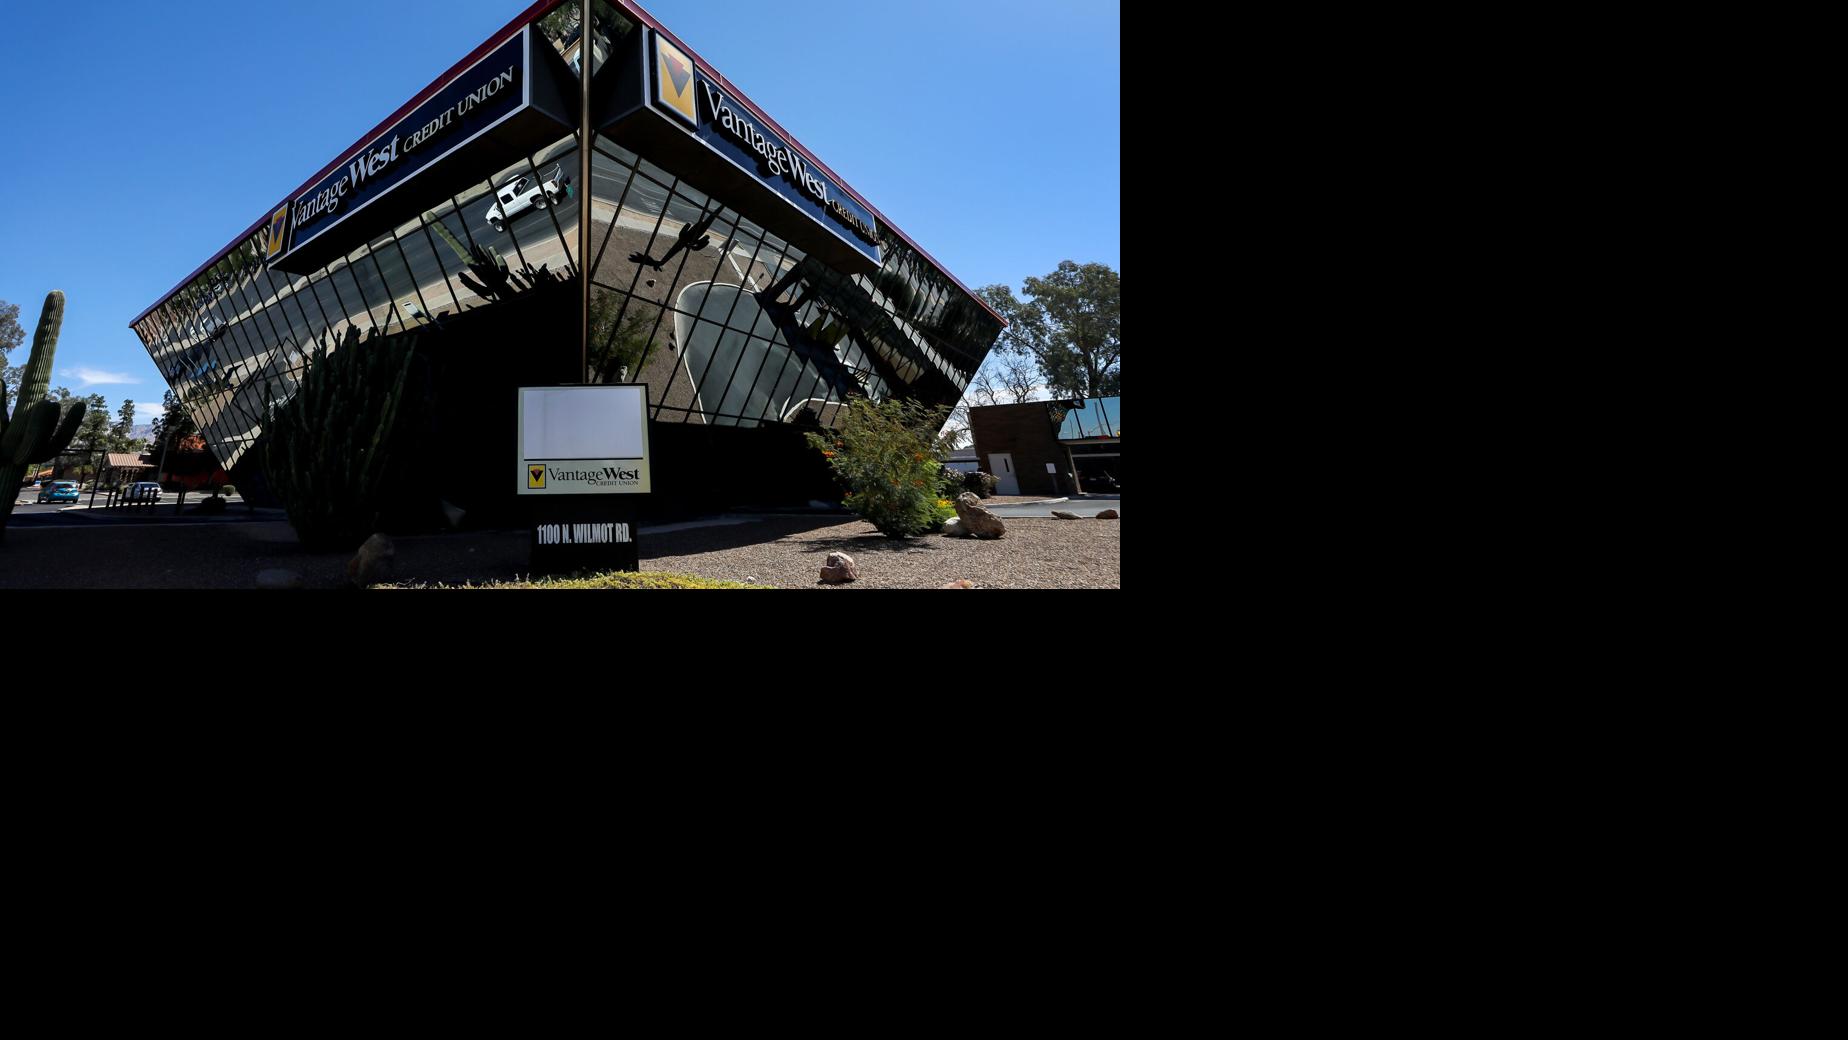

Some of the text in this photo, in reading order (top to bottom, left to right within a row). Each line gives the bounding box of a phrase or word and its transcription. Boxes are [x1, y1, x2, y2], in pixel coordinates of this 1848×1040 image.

[403, 106, 454, 153] CREDIT
[457, 65, 514, 116] UNION
[702, 80, 831, 205] VantageWest
[548, 467, 640, 485] VantageWest
[537, 523, 632, 544] 1100 N. WILMOT RD.
